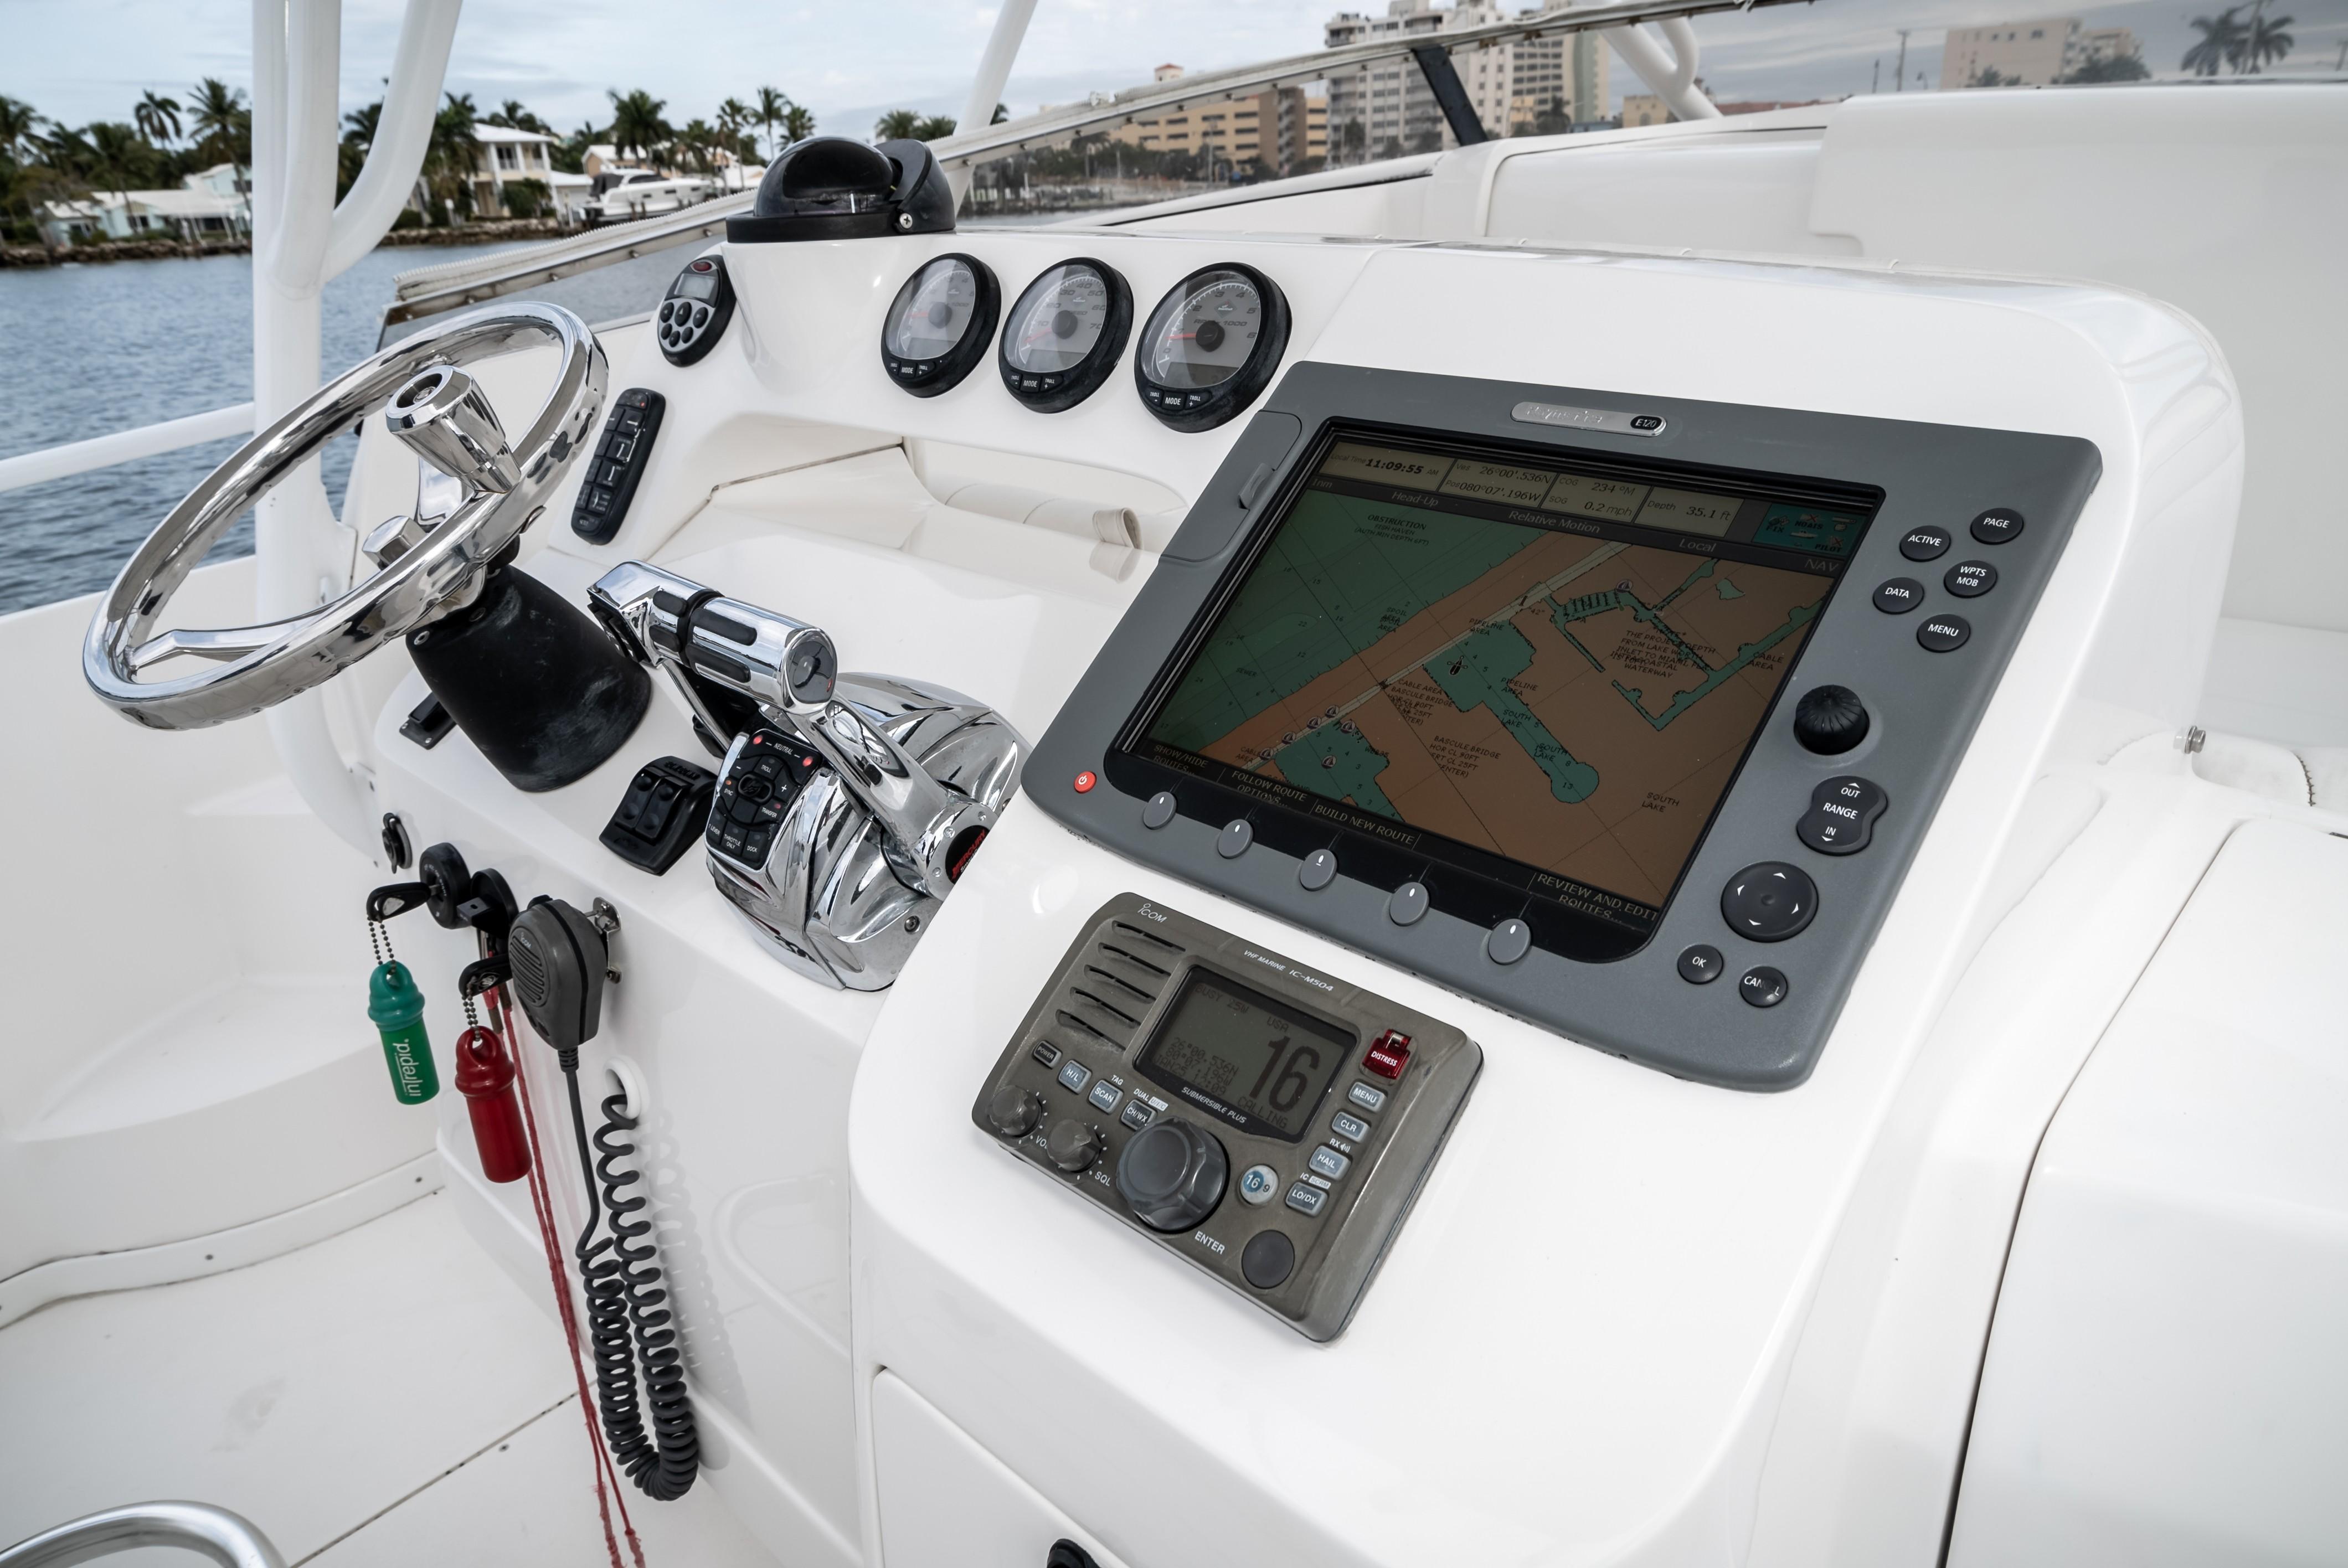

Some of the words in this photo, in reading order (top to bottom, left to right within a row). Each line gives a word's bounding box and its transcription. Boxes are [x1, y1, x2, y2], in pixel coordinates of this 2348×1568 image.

[1165, 397, 1181, 405] MODE
[1635, 419, 1657, 428] E120
[1331, 453, 1349, 462] Local
[1366, 458, 1424, 474] 11:09:55
[1456, 463, 1471, 471] Ves
[1445, 479, 1460, 488] Pos
[1559, 477, 1579, 486] COG
[1590, 482, 1616, 494] 234
[1391, 491, 1439, 507] Head-Up
[1549, 496, 1568, 504] SOG
[1584, 501, 1605, 512] 0.2
[1606, 506, 1633, 517] mph
[1647, 501, 1676, 512] Depth
[1686, 507, 1716, 519] 35.1
[1719, 510, 1731, 521] ft
[1367, 514, 1427, 530] OBSTRUCTION
[1509, 511, 1557, 526] Relative
[1558, 519, 1600, 533] Motion
[1766, 525, 1785, 533] FIX
[1983, 517, 2010, 529] PAGE
[1391, 527, 1416, 535] HAVEN
[1390, 534, 1414, 543] DEPTH
[1679, 538, 1717, 553] Local
[1908, 534, 1942, 546] ACTIVE
[1814, 543, 1844, 553] PILOT
[1804, 559, 1839, 572] NAV
[1960, 565, 1987, 577] WPTS
[1956, 576, 1979, 587] MOB
[1884, 587, 1910, 599] DATA
[1626, 630, 1644, 638] THE
[1927, 623, 1959, 637] MENU
[1616, 645, 1644, 656] INLET
[1645, 651, 1657, 659] TO
[1621, 638, 1645, 648] FROM
[1646, 644, 1669, 653] LAKE
[1753, 651, 1784, 664] CABLE
[1624, 663, 1674, 678] WATERWAY
[1749, 661, 1774, 671] AREA
[1398, 679, 1422, 690] CABLE
[1422, 685, 1443, 696] AREA
[1500, 677, 1539, 692] PIPELINE
[1391, 686, 1425, 700] BASCULE
[1425, 695, 1453, 708] BRIDGE
[1502, 709, 1532, 721] SOUTH
[1501, 718, 1522, 728] LAKE
[774, 742, 794, 755] NEUTRAL
[1429, 743, 1447, 753] HOR
[1448, 749, 1458, 757] CL
[1433, 735, 1470, 750] BASCULE
[1470, 745, 1501, 760] BRIDGE
[1154, 744, 1209, 768] SHOW/HIDE
[1533, 751, 1556, 762] LAKE
[760, 764, 772, 774] TROLL
[1458, 761, 1479, 771] 25FT
[724, 788, 734, 796] SYNC
[1232, 770, 1273, 790] FOLLOW
[1273, 784, 1308, 802] ROUTE
[1841, 787, 1861, 798] OUT
[1641, 800, 1666, 813] LAKE
[1646, 792, 1680, 807] SOUTH
[761, 807, 778, 818] TRANSFER
[1822, 802, 1858, 820] RANGE
[710, 825, 720, 837] LEVER
[1315, 804, 1348, 822] BUILD
[1348, 816, 1376, 831] NEW
[1376, 826, 1416, 845] ROUTE
[1825, 826, 1836, 836] IN
[723, 833, 742, 847] THROTTLE
[725, 842, 736, 850] ONLY
[952, 829, 985, 880] MERCURY
[1537, 874, 1592, 899] REVIEW
[1593, 893, 1621, 909] AND
[1625, 903, 1659, 921] EDIT
[1692, 956, 1707, 968] OK
[1243, 949, 1259, 961] VHF
[1258, 955, 1286, 972] MARINE
[1289, 969, 1334, 992] IC-M504
[1194, 983, 1223, 1003] BUSY
[1227, 998, 1250, 1015] 25W
[1266, 1015, 1290, 1033] USA
[1037, 1046, 1055, 1060] POWER
[1371, 1050, 1398, 1067] DISTRESS
[1065, 1068, 1080, 1082] H/L
[1111, 1074, 1124, 1086] TAG
[1249, 1035, 1321, 1113] 16
[1094, 1087, 1115, 1103] SCAN
[1133, 1088, 1150, 1102] DUAL
[1353, 1087, 1378, 1103] MENU
[1181, 1086, 1228, 1115] SUBMERSIBLE
[1227, 1110, 1248, 1125] PLUS
[1237, 1096, 1289, 1129] CALLING
[1126, 1106, 1148, 1123] CH/WX
[1340, 1119, 1357, 1133] CLR
[1330, 1137, 1340, 1148] RX
[1317, 1153, 1336, 1169] HAIL
[1094, 1171, 1111, 1187] SQL
[1300, 1172, 1309, 1181] IC
[1246, 1174, 1260, 1189] 16
[1263, 1183, 1271, 1194] 9
[1291, 1189, 1317, 1205] LO/DX
[1194, 1230, 1226, 1256] ENTER
